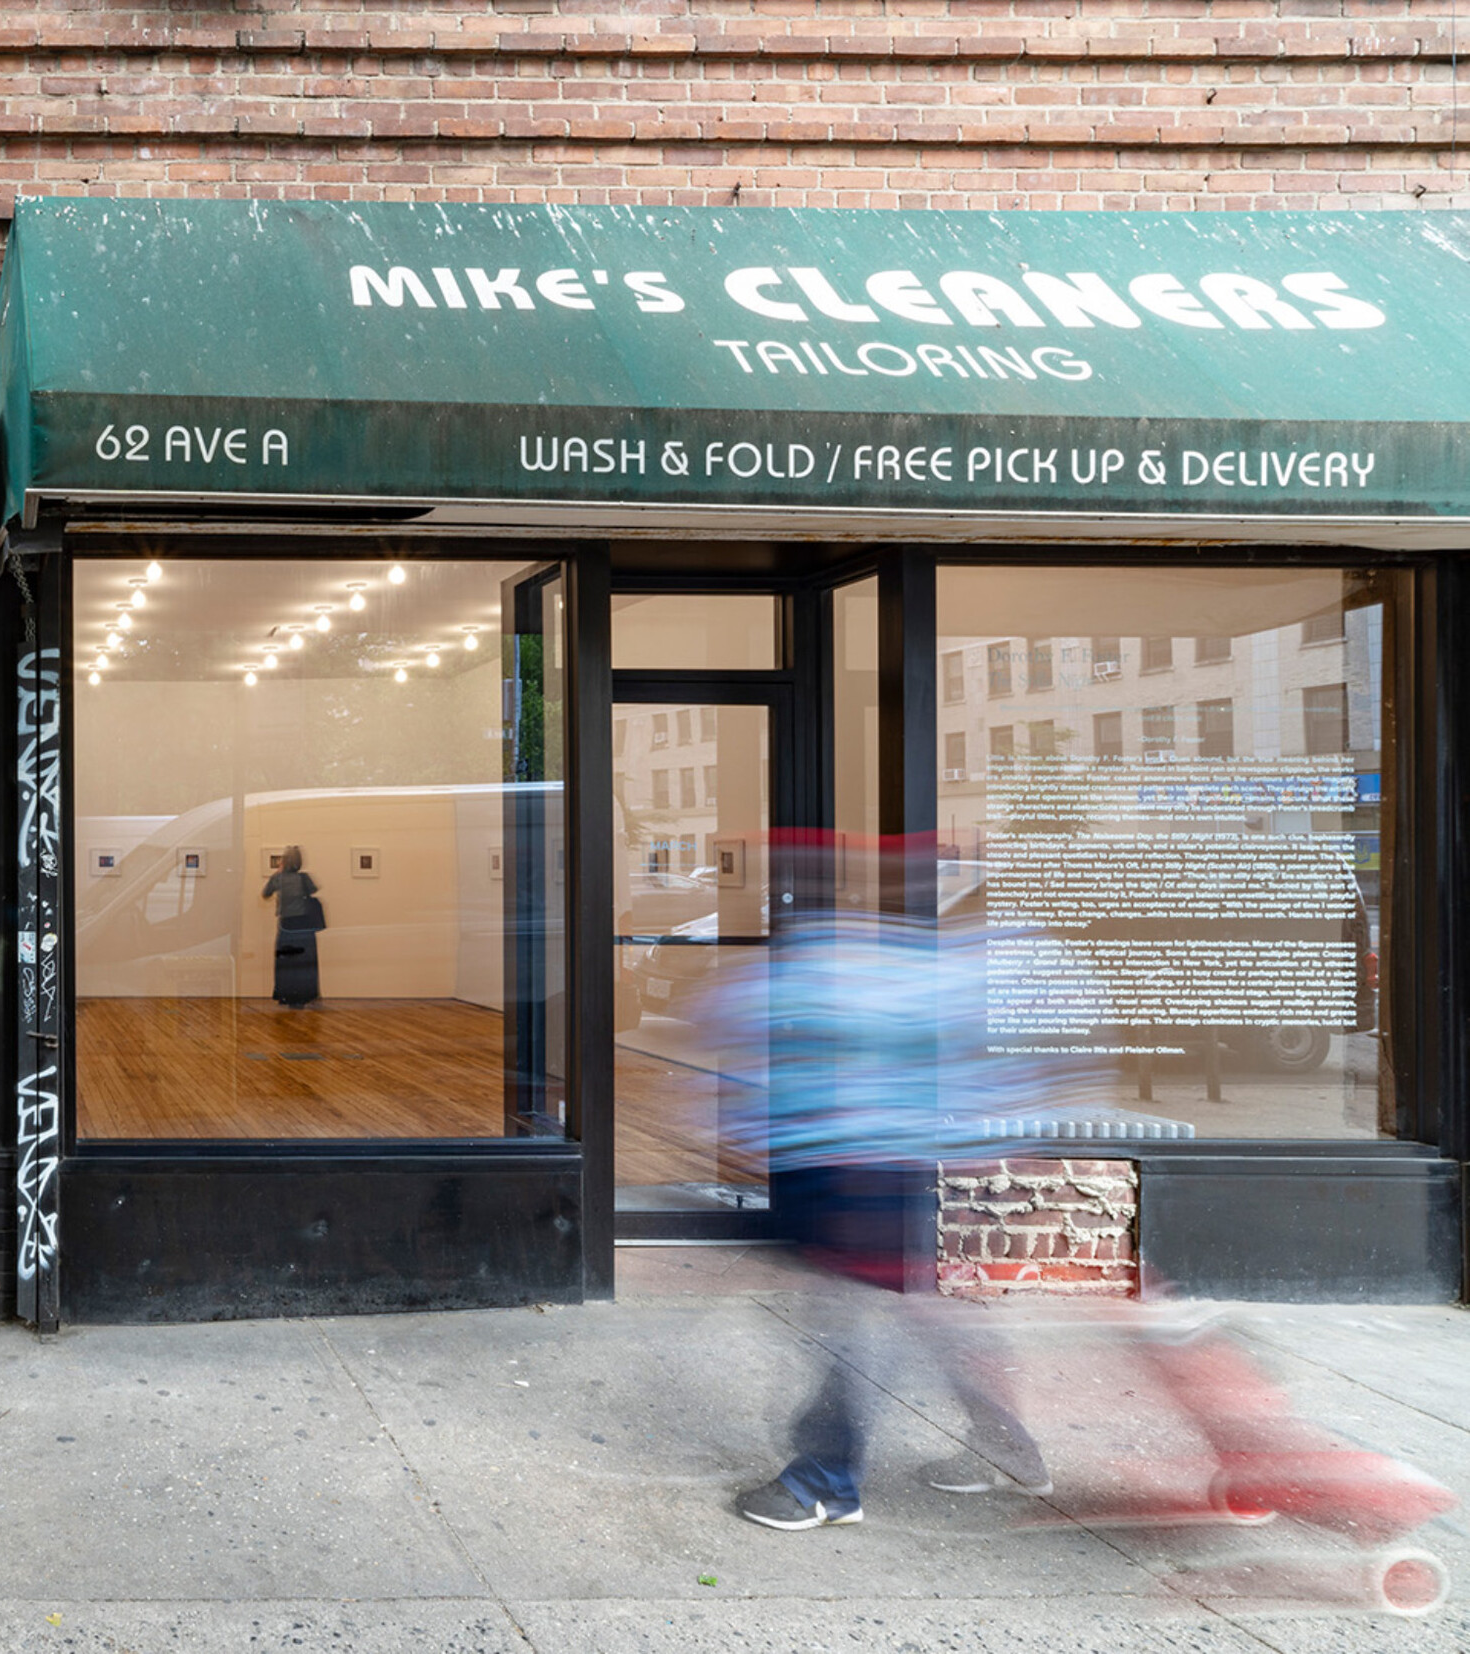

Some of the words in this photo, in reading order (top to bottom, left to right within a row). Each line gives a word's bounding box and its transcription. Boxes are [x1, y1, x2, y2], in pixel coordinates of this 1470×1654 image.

[349, 265, 685, 313] MIKE'S
[724, 267, 1386, 330] CLEANERS
[714, 340, 1093, 381] TAILORING
[95, 425, 150, 462] 62
[165, 426, 247, 465] AVE
[263, 429, 289, 466] A
[520, 436, 646, 475] WASH
[661, 441, 690, 477] &
[705, 442, 816, 479] FOLD
[854, 445, 953, 482] FREE
[967, 446, 1059, 484] PICK
[1071, 448, 1126, 485] UP
[1137, 449, 1168, 486] &
[1182, 450, 1376, 488] DELIVERY
[649, 841, 697, 851] MARCH
